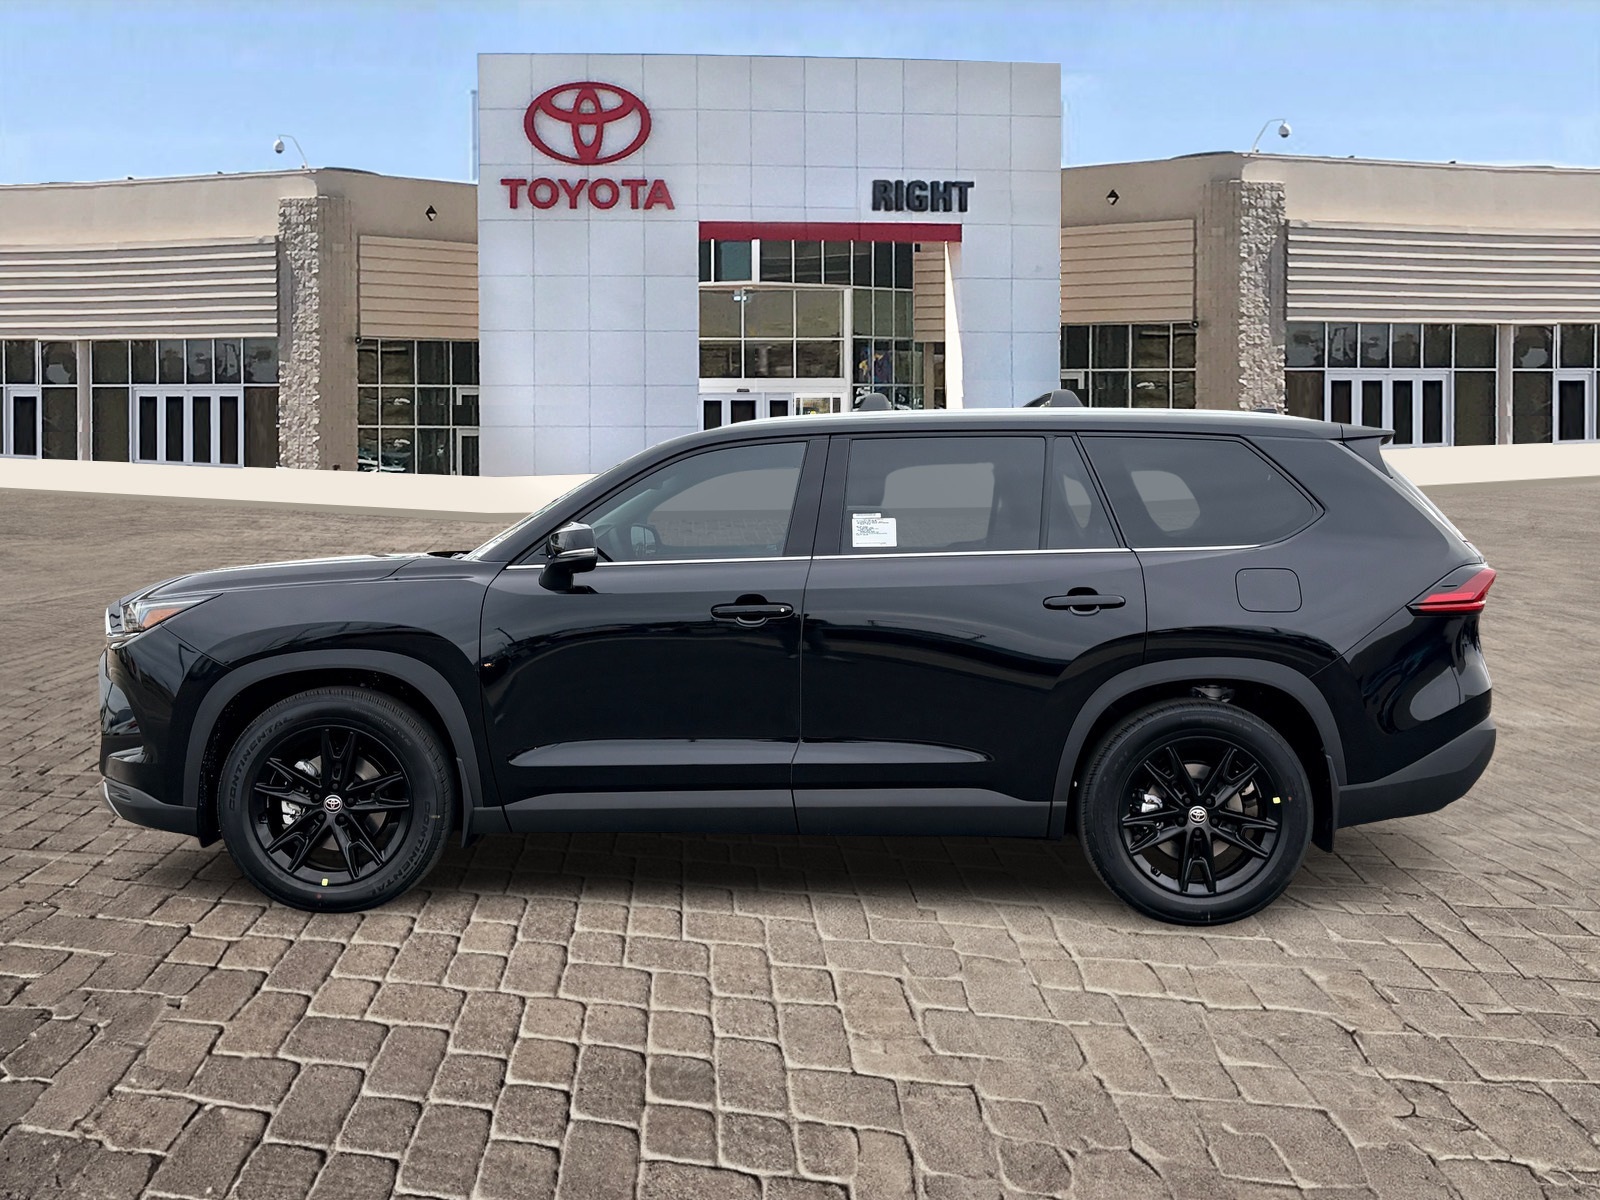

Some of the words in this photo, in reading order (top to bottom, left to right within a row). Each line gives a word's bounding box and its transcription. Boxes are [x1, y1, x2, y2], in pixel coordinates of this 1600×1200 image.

[500, 177, 675, 210] TOYOTA
[871, 179, 975, 213] RIGHT
[228, 716, 294, 812] CONTINENTAL
[371, 800, 431, 895] CONTINENTAL
